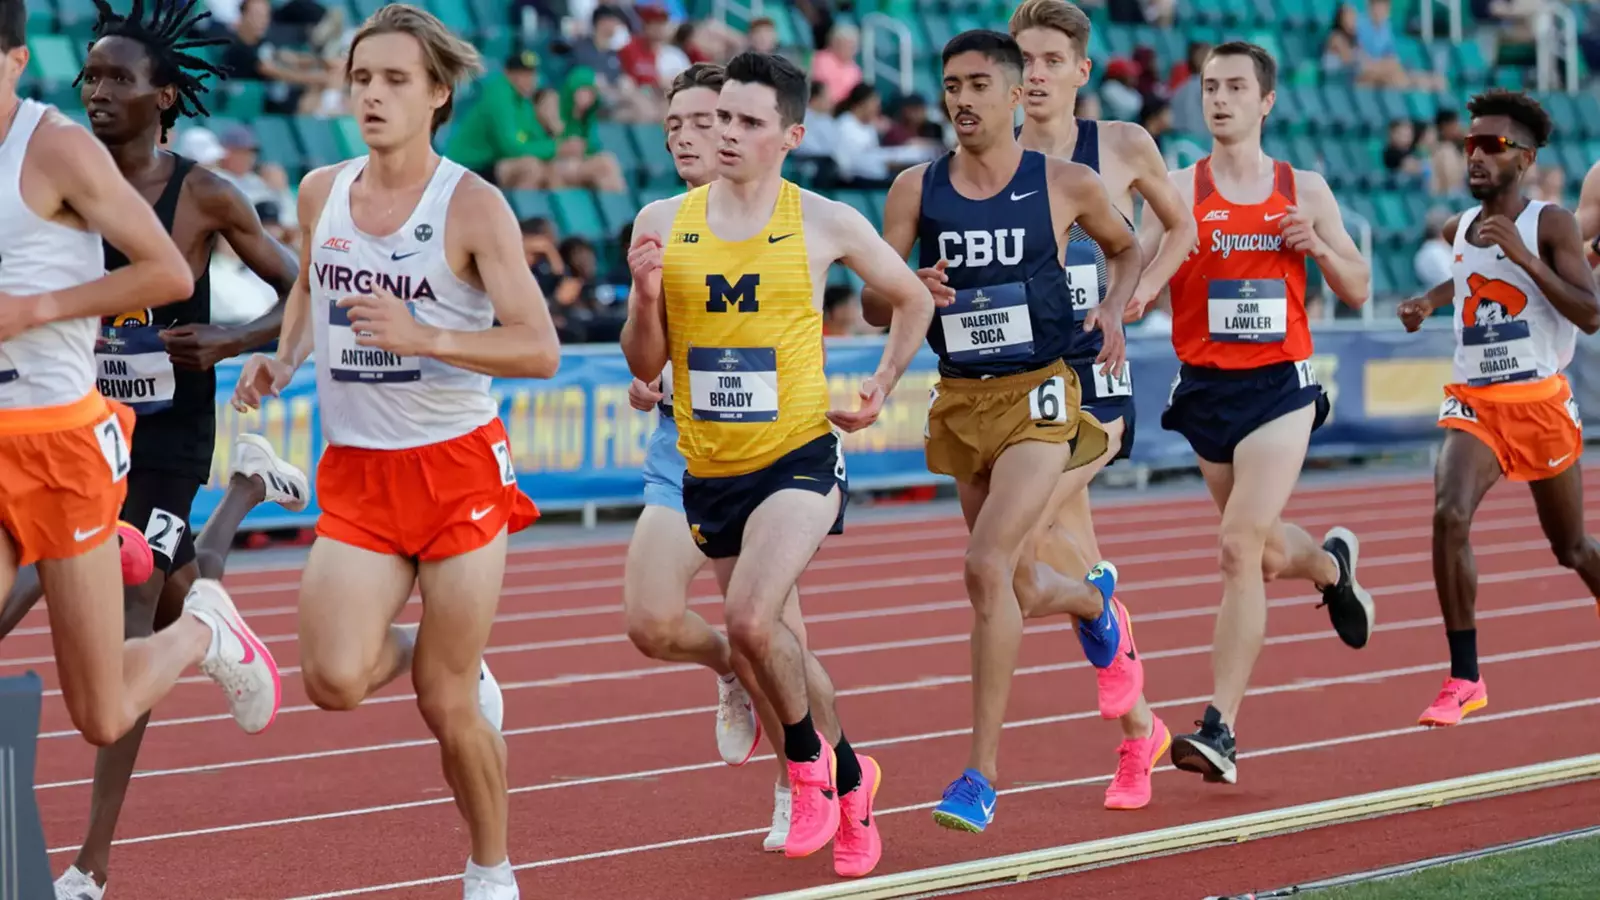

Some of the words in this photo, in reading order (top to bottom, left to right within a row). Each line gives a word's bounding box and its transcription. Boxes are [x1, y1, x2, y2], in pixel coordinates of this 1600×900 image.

[1202, 210, 1230, 221] ACC
[323, 236, 352, 250] ACC
[938, 228, 1026, 268] CBU
[1211, 229, 1282, 259] Syracuse
[314, 262, 438, 301] VIRGINIA
[705, 274, 760, 312] M
[1236, 303, 1259, 314] SAM
[960, 312, 1010, 329] VALENTIN
[1225, 316, 1272, 330] LAWLER
[970, 328, 1006, 345] SOCA
[341, 349, 402, 367] ANTHONY
[1479, 356, 1519, 374] GUADIA
[103, 360, 128, 376] IAN
[96, 378, 156, 398] BIWOT
[717, 375, 742, 389] TOM
[709, 391, 754, 408] BRADY
[1037, 379, 1060, 421] 6
[148, 513, 186, 559] 21
